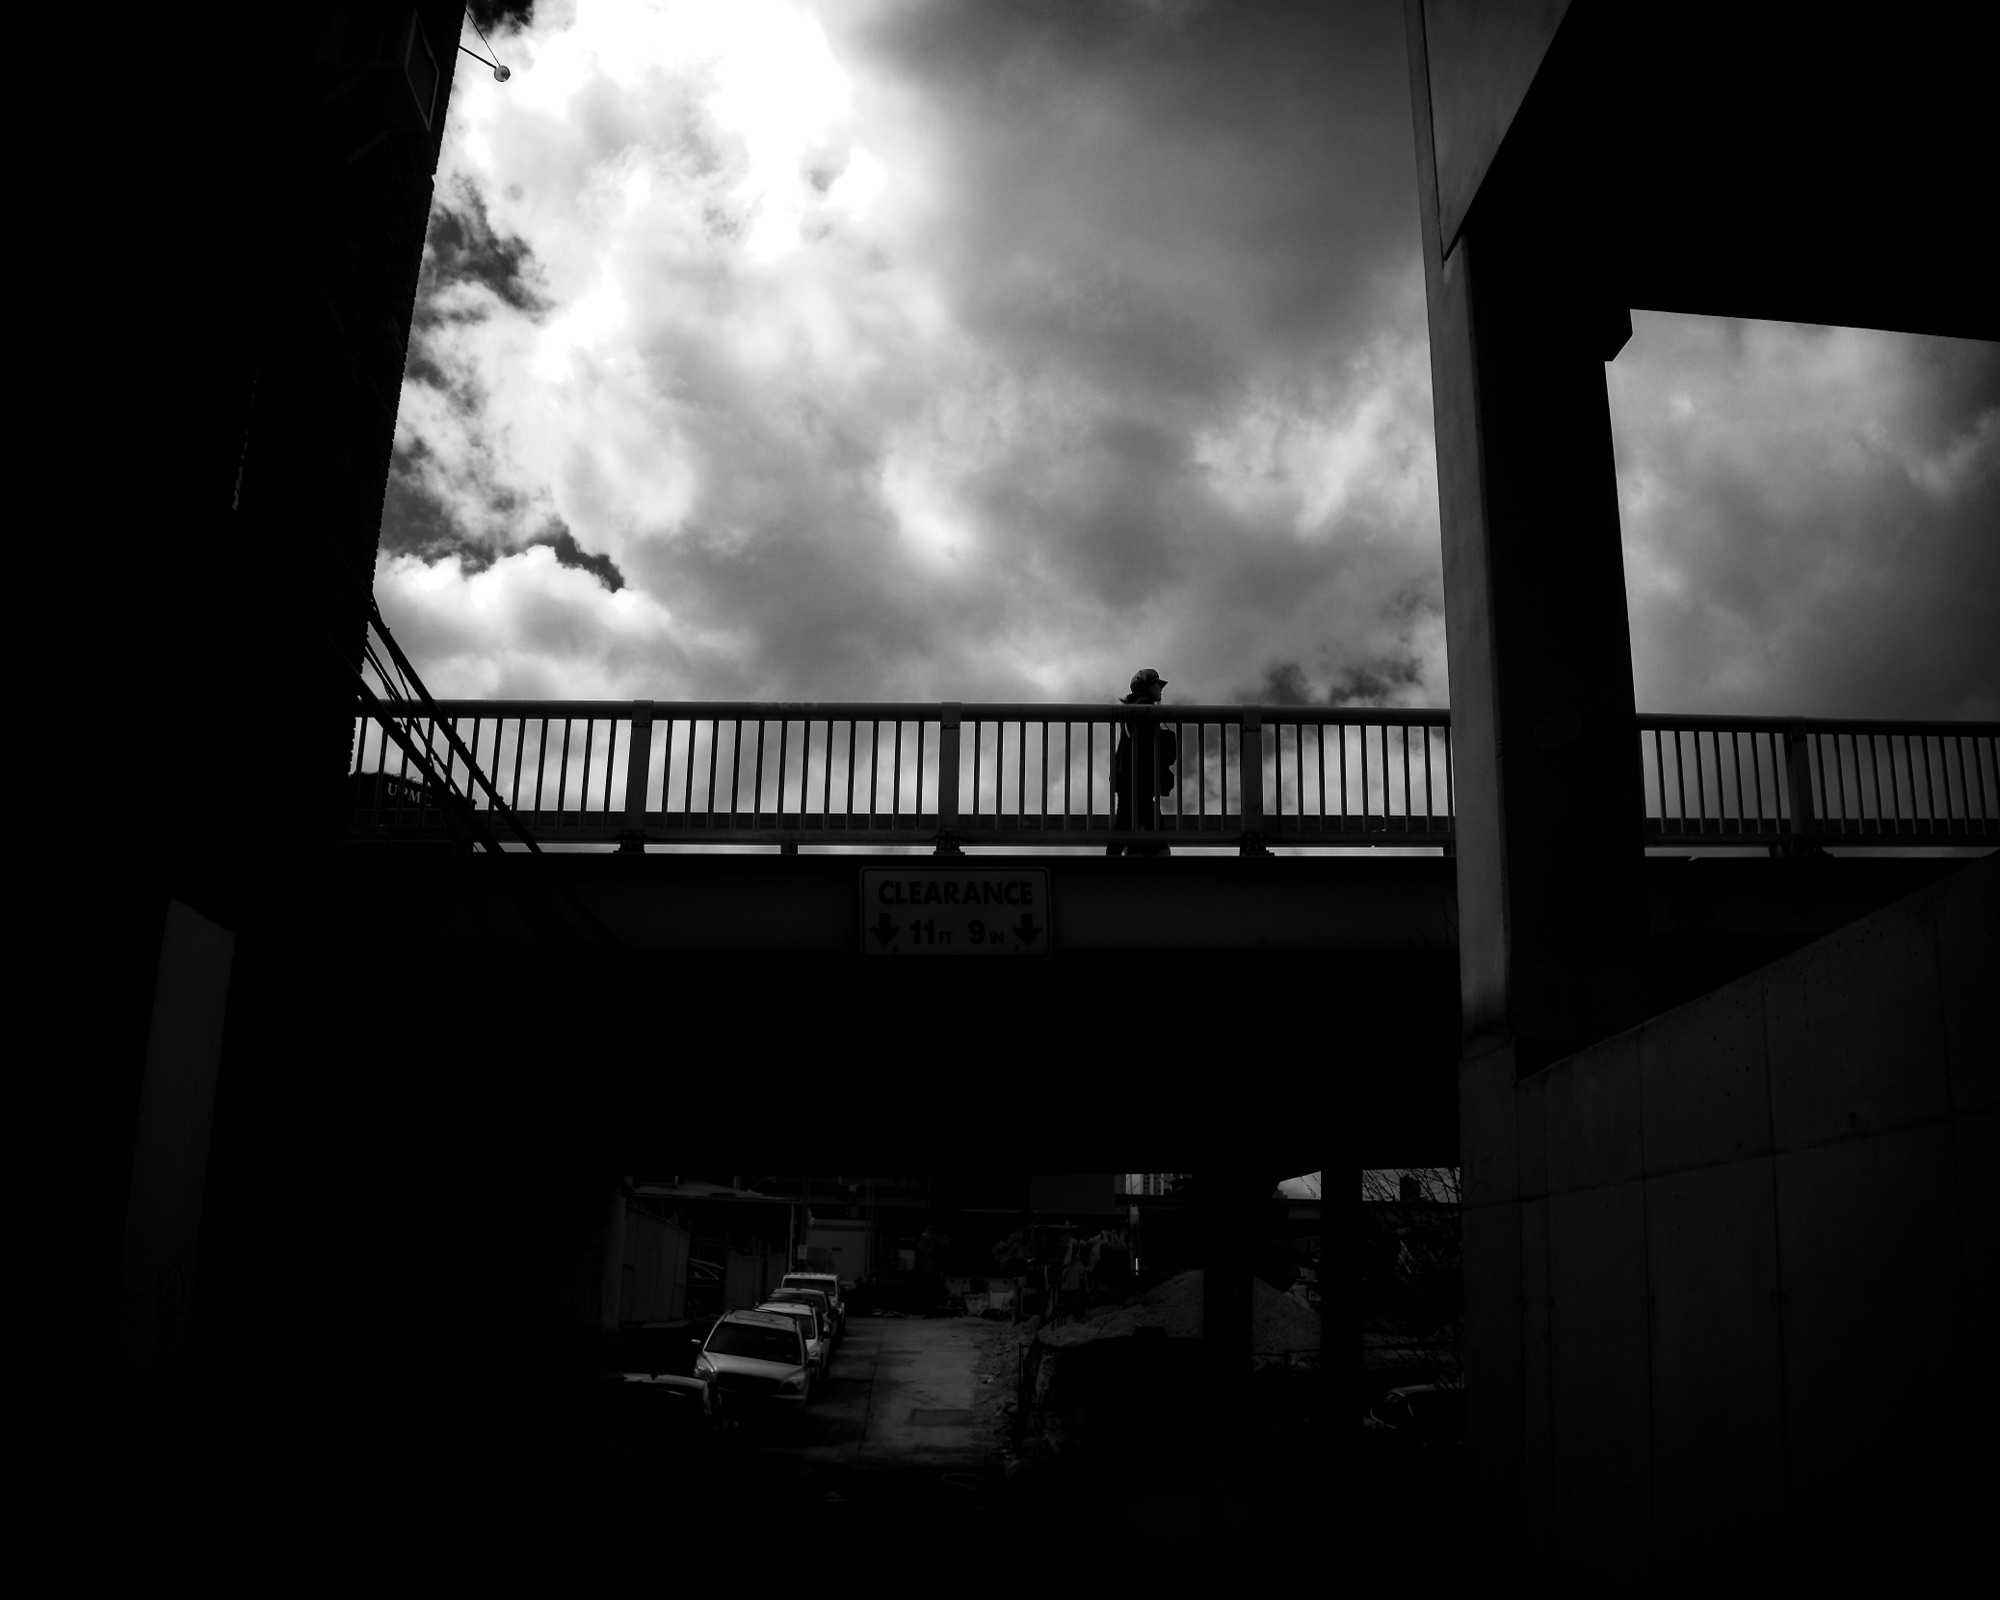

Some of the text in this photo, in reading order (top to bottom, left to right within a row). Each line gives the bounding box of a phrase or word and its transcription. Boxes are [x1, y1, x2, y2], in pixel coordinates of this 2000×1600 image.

[878, 881, 1033, 905] CLEARANCE
[910, 919, 1004, 945] 11 FT 9 IN
